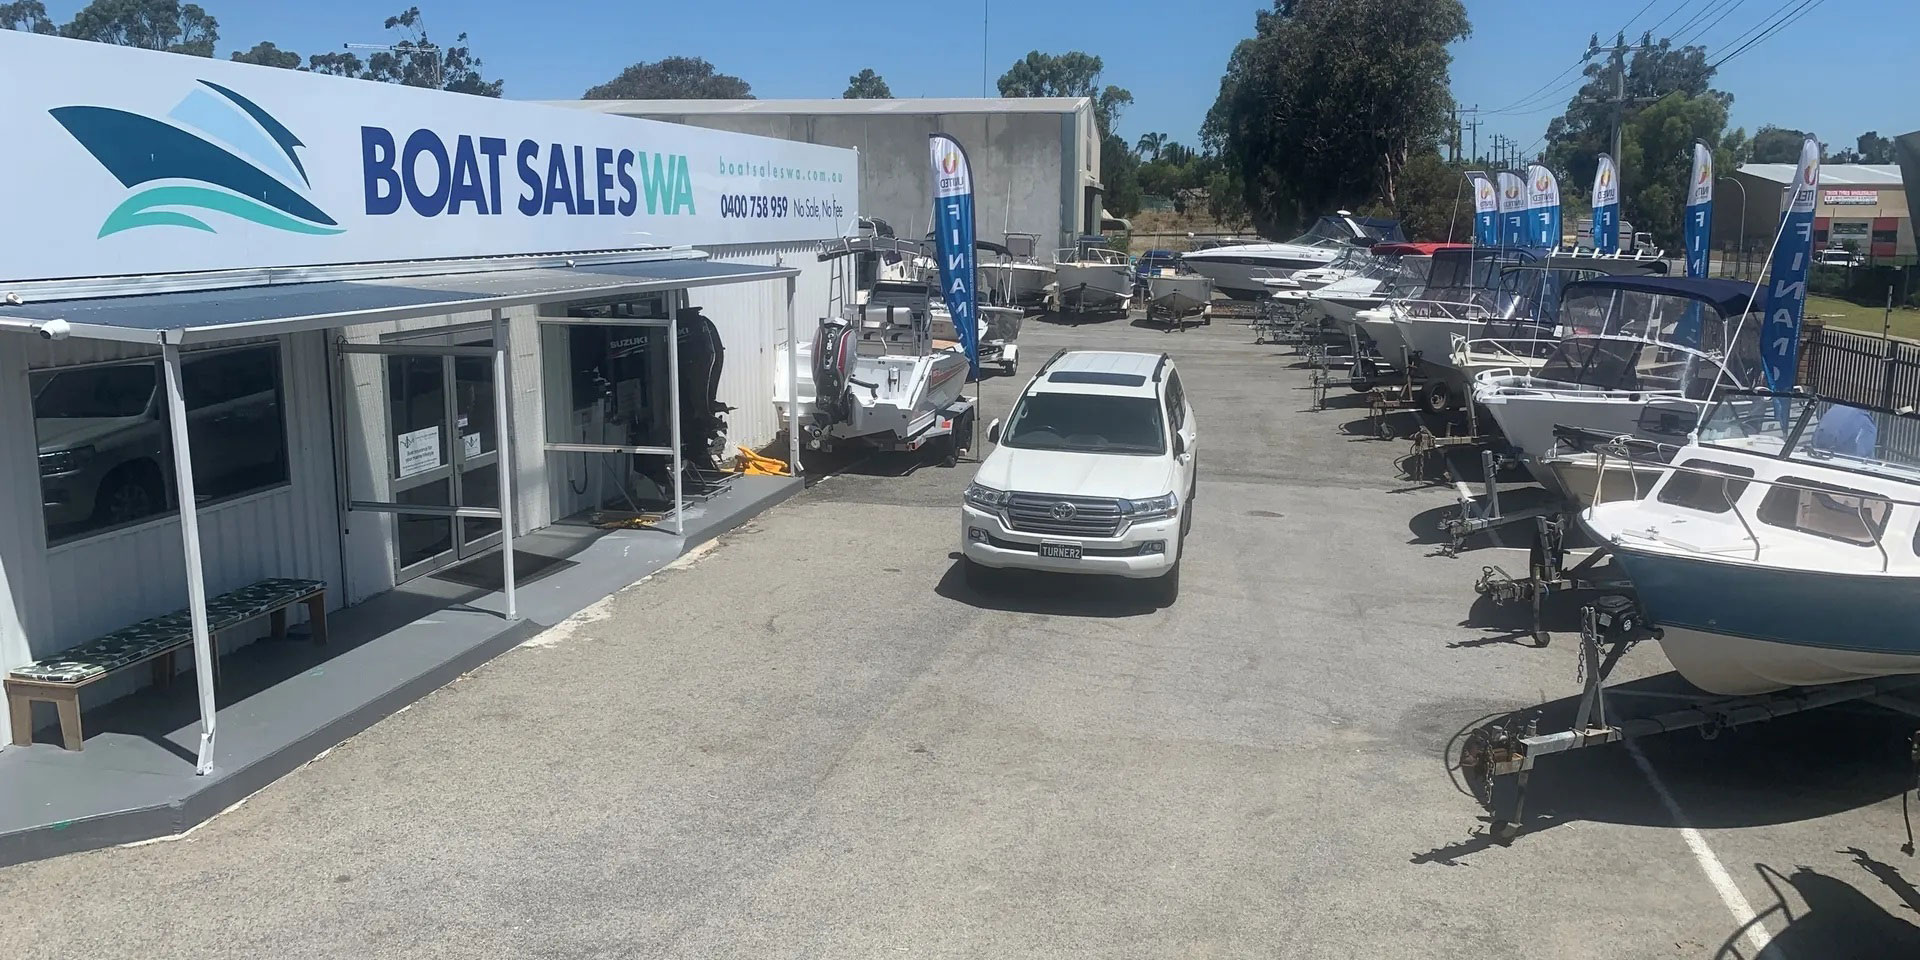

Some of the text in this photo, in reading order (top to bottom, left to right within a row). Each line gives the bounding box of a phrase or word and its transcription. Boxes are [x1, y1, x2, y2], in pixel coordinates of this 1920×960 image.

[361, 126, 507, 217] BOAT
[720, 155, 843, 183] boatsaleswa.com.au
[720, 194, 748, 218] 0400
[750, 196, 769, 218] 758
[770, 196, 788, 218] 959
[793, 199, 804, 218] No
[822, 200, 832, 218] No
[610, 335, 648, 349] SUZUKI
[1042, 546, 1081, 559] TURNER2
